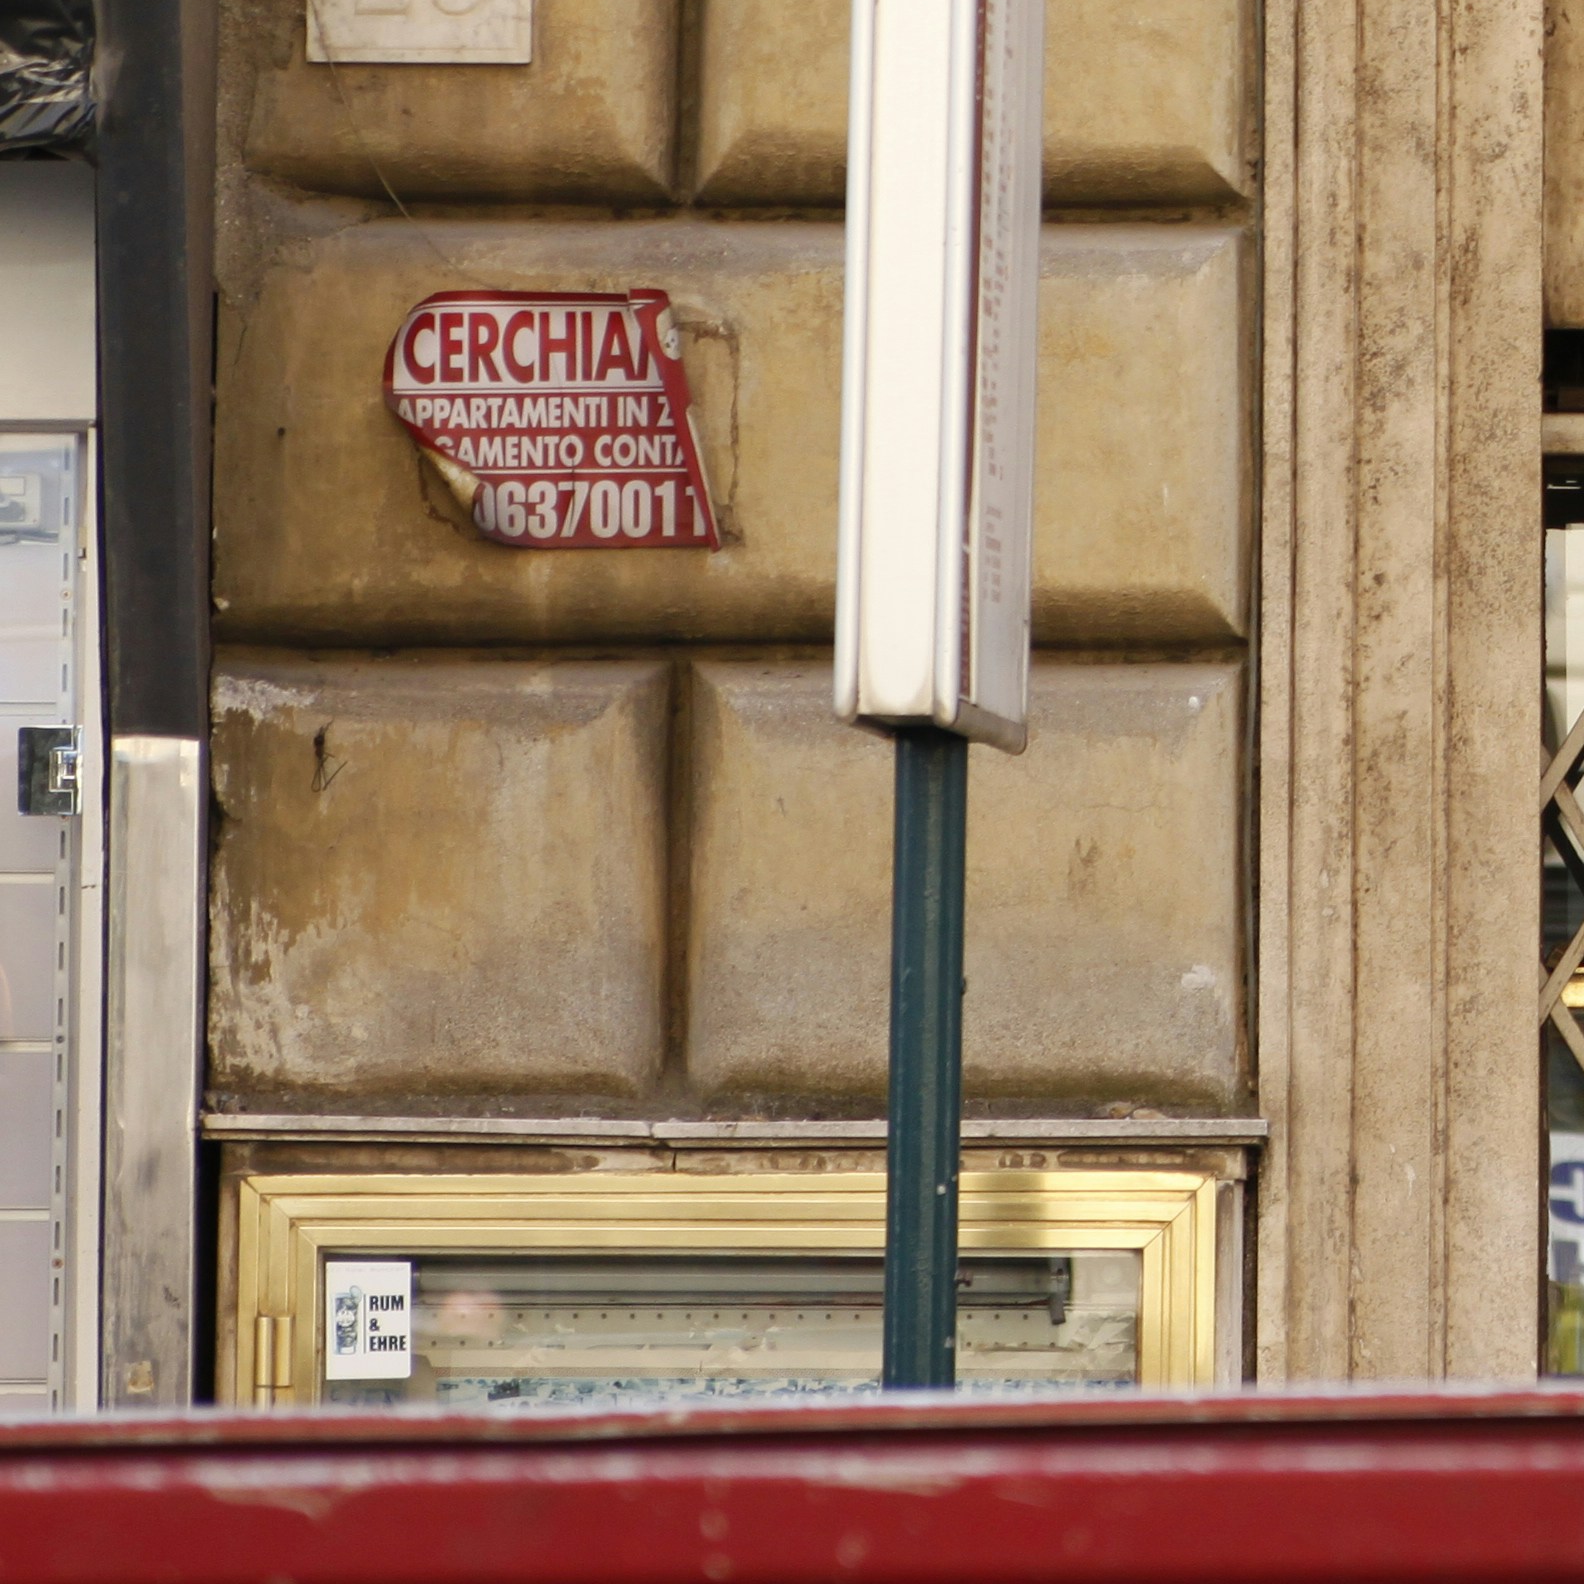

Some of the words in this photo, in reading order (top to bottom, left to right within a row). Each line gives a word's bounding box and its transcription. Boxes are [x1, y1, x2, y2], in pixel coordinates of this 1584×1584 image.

[399, 394, 609, 430] APPARTAMENTI
[616, 395, 650, 429] IN
[369, 1295, 404, 1311] RUM
[368, 1318, 381, 1332] &
[369, 1335, 407, 1352] EHRE
